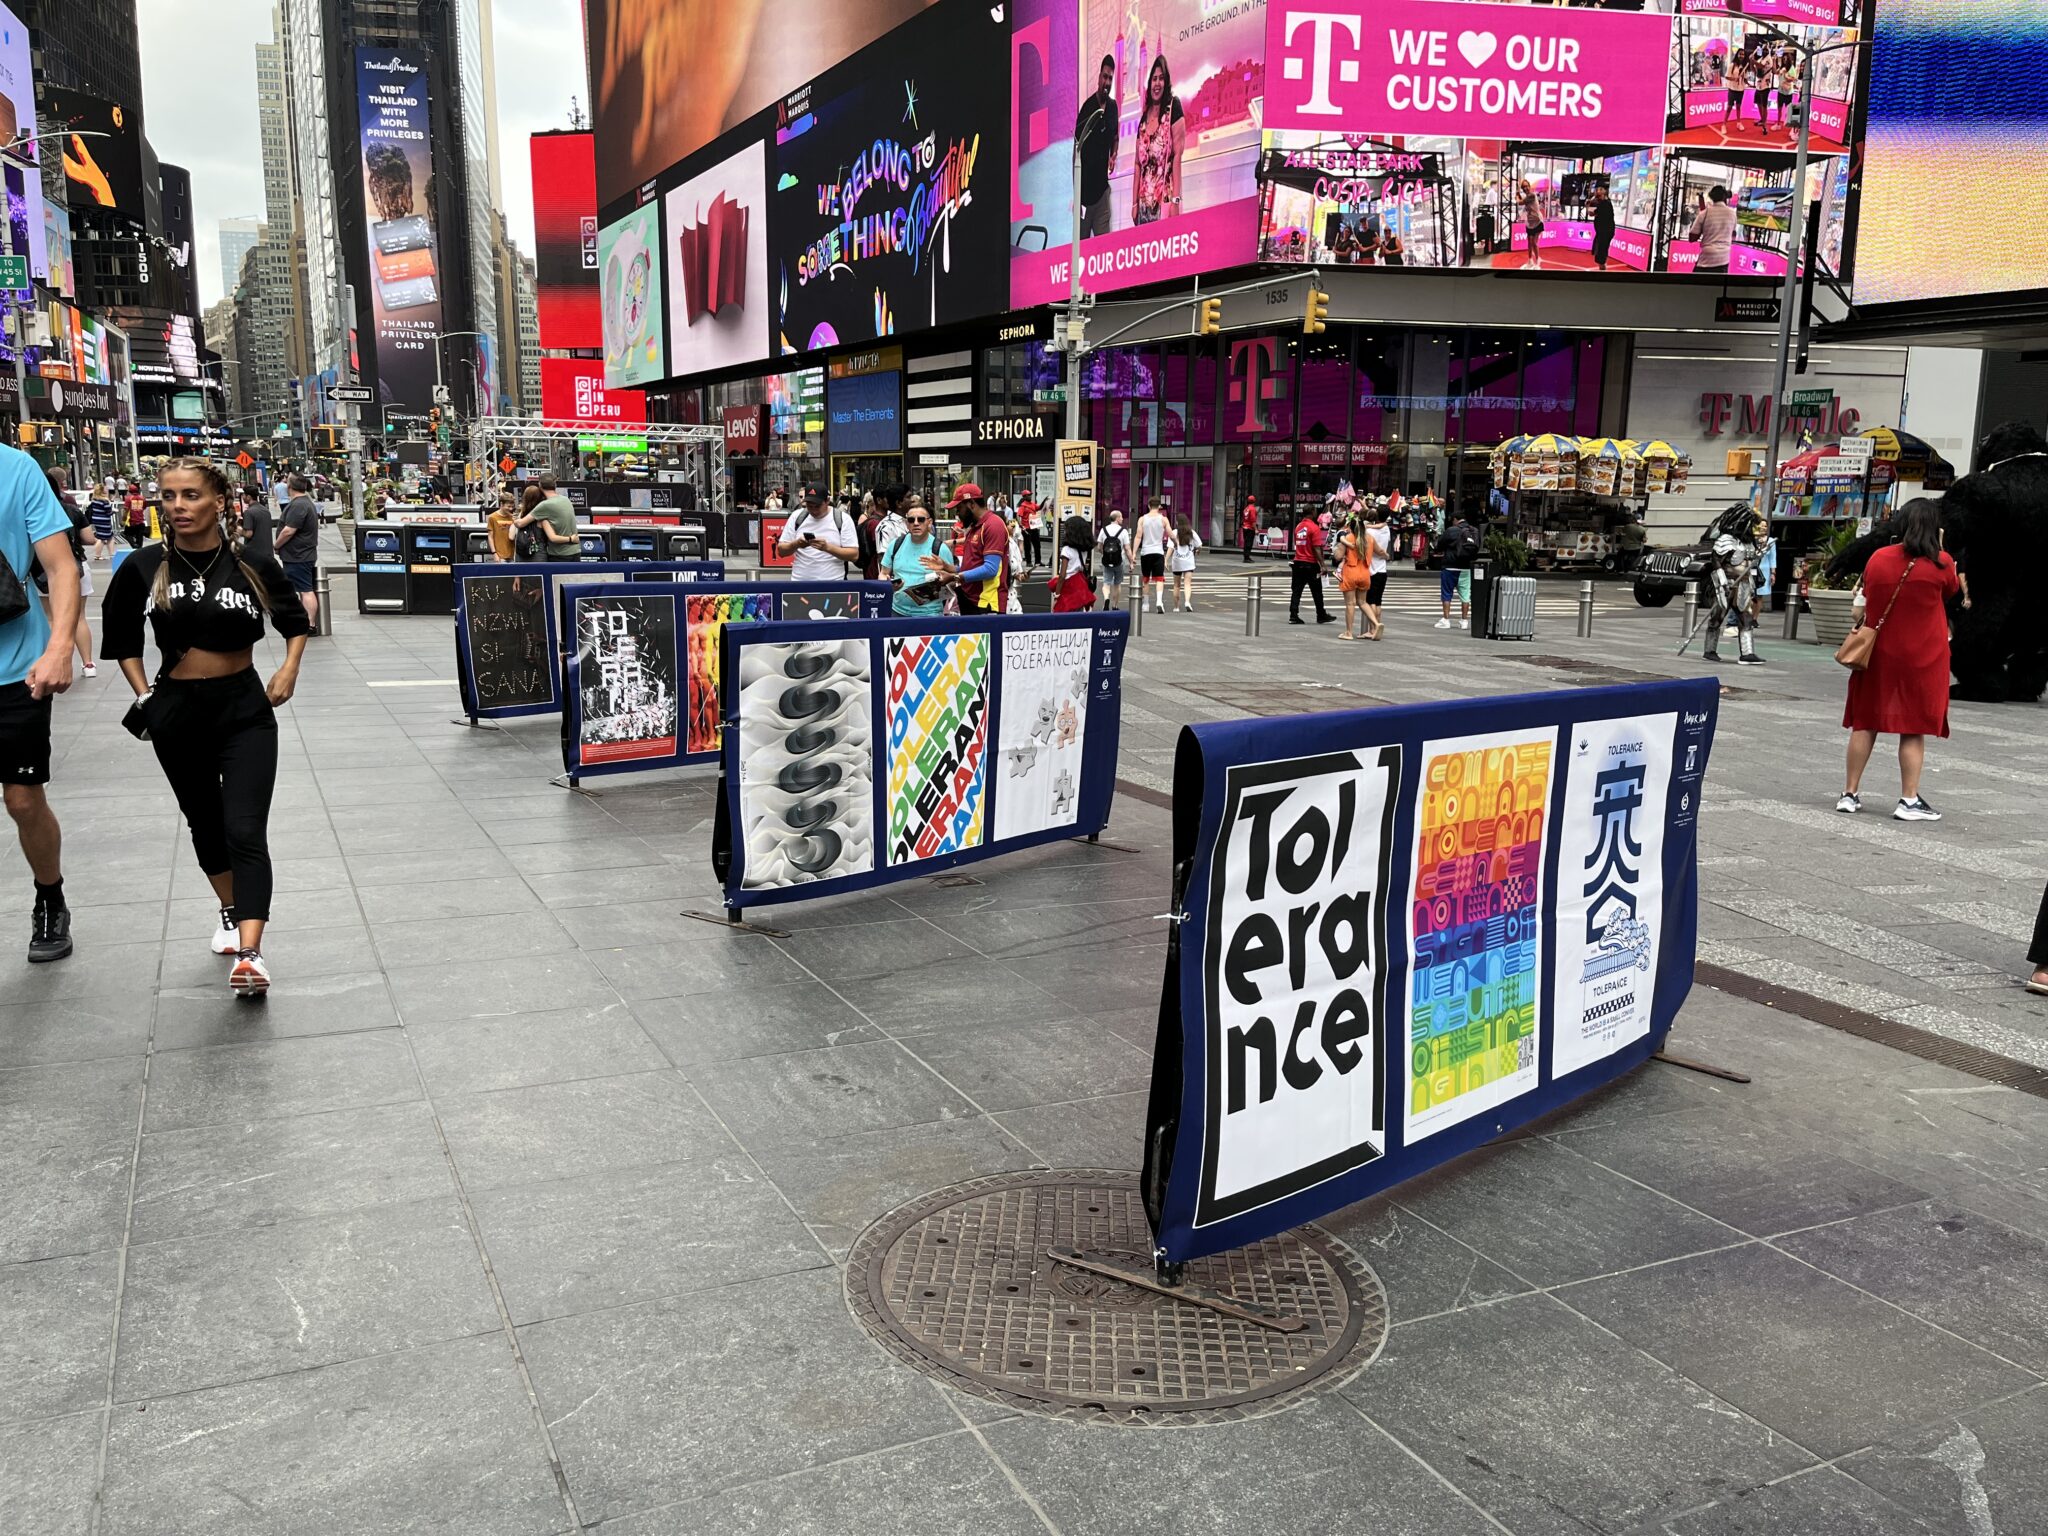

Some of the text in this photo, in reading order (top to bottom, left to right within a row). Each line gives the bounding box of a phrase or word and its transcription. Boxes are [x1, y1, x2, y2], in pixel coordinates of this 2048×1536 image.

[1179, 28, 1189, 41] ON
[1191, 21, 1204, 36] THE
[1205, 6, 1239, 30] GROUND.
[1241, 1, 1250, 14] IN
[1815, 6, 1835, 21] BIG!
[1389, 29, 1580, 73] WE OUR
[380, 85, 405, 94] VISIT
[787, 85, 812, 107] MARRIOTT
[1386, 74, 1603, 118] CUSTOMERS
[368, 95, 418, 107] THAILAND
[788, 100, 809, 118] MARQUIS
[1689, 102, 1722, 115] SWING
[381, 107, 406, 116] WITH
[380, 118, 409, 128] MORE
[1820, 112, 1841, 128] BIG!
[367, 129, 424, 140] PRIVILEGES
[1376, 152, 1424, 171] PARK
[817, 129, 936, 223] WE BELONG TO
[1313, 177, 1373, 204] COSTA
[798, 206, 907, 287] SOMETHING
[1627, 241, 1645, 257] BIG!
[138, 242, 149, 283] 1500
[1050, 231, 1199, 284] WE OUR CUSTOMERS
[15, 268, 22, 276] St
[1265, 289, 1289, 305] 1535
[382, 319, 435, 330] THAILAND
[999, 324, 1035, 340] SEPHORA
[381, 330, 438, 340] PRIVILEGE
[395, 341, 425, 350] CARD
[64, 386, 96, 413] sunglass
[97, 388, 109, 411] hut
[594, 392, 604, 402] IN
[1041, 391, 1048, 400] W
[1050, 390, 1058, 399] 46
[1794, 391, 1831, 403] Broadway
[593, 404, 621, 416] PERU
[832, 406, 894, 424] Master The Elements
[1792, 406, 1811, 416] W 46
[978, 417, 1043, 441] SEPHORA
[1063, 448, 1089, 458] EXPLORE
[1304, 445, 1346, 453] THE BEST 5G
[1064, 456, 1082, 465] MORE
[1065, 463, 1089, 474] IN TIMES
[1066, 471, 1089, 481] SQUARE
[1815, 485, 1851, 493] HOT DOG
[1005, 650, 1087, 671] TOLERANCIJA
[477, 668, 545, 698] SANA
[1608, 741, 1644, 756] TOLERANCE
[1238, 779, 1356, 902] Tol
[1224, 891, 1371, 1005] era
[1593, 976, 1628, 997] TOLERANCE
[1226, 988, 1370, 1116] nce
